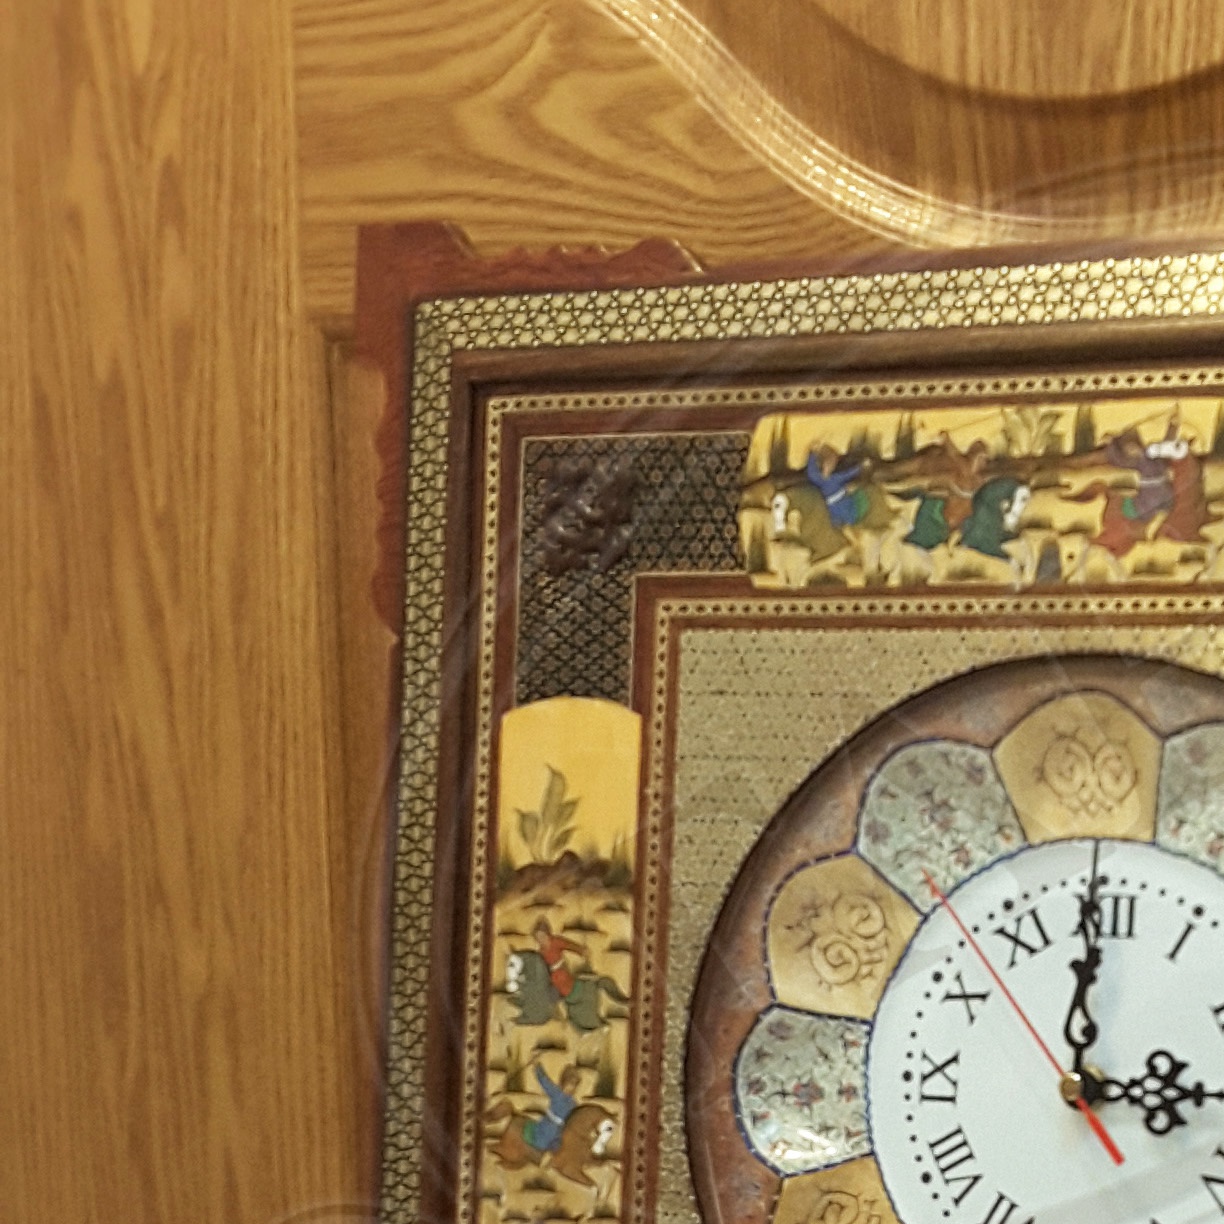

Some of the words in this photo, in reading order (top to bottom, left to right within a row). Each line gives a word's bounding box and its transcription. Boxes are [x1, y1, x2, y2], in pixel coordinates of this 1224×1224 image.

[994, 908, 1052, 969] XI
[1168, 922, 1197, 962] I
[943, 972, 990, 1023] X
[919, 1051, 961, 1104] IX
[929, 1126, 983, 1206] VIII
